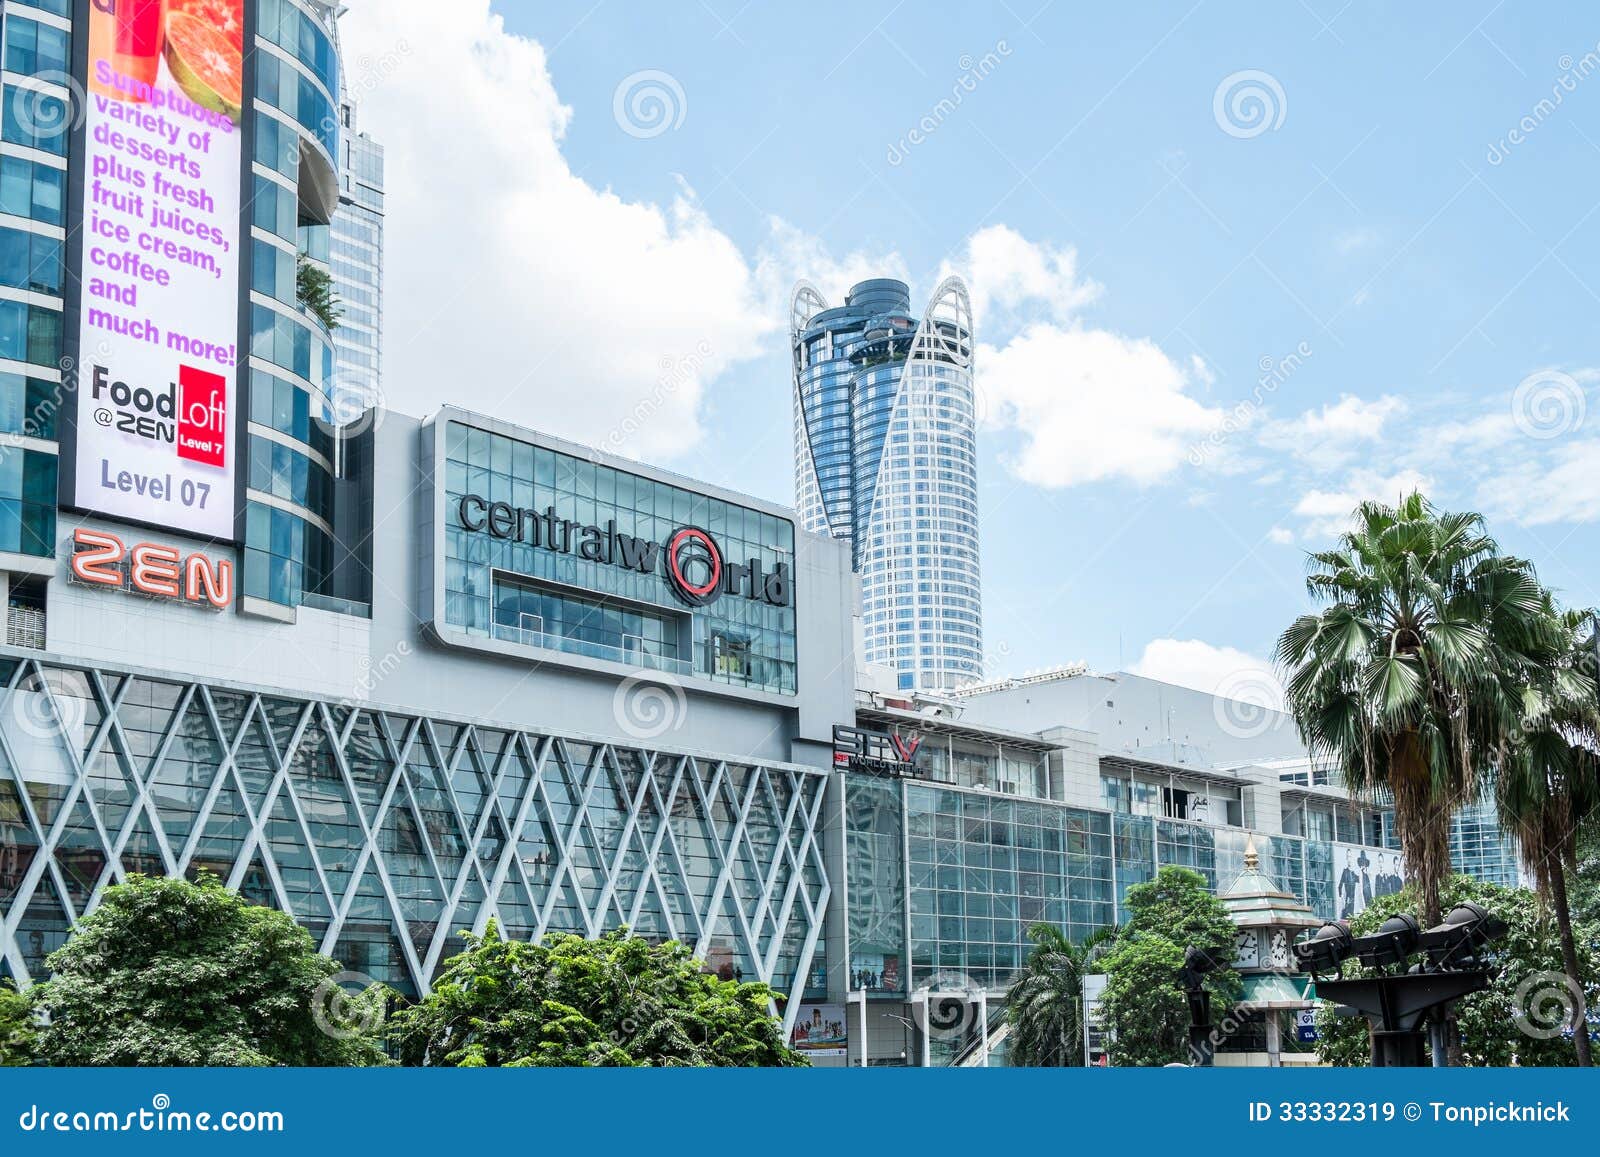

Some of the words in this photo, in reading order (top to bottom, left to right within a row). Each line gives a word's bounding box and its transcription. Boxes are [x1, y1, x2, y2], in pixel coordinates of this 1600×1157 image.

[94, 94, 181, 145] variety
[188, 132, 211, 153] of
[95, 60, 234, 133] Sumptuous
[93, 122, 201, 179] desserts
[92, 154, 146, 189] plus
[153, 171, 214, 214] fresh
[91, 209, 130, 243] ice
[138, 232, 221, 279] cream,
[92, 180, 144, 219] fruit
[150, 200, 230, 252] juices,
[88, 277, 137, 307] and
[90, 247, 170, 286] coffee
[88, 308, 159, 344] much
[167, 331, 235, 366] more!
[92, 364, 177, 420] Food
[179, 384, 225, 433] Loft
[116, 411, 175, 444] ZEN
[180, 434, 212, 452] Level
[214, 443, 223, 455] 7
[101, 459, 171, 502] Level
[180, 479, 211, 509] 07
[71, 528, 233, 608] ZEN
